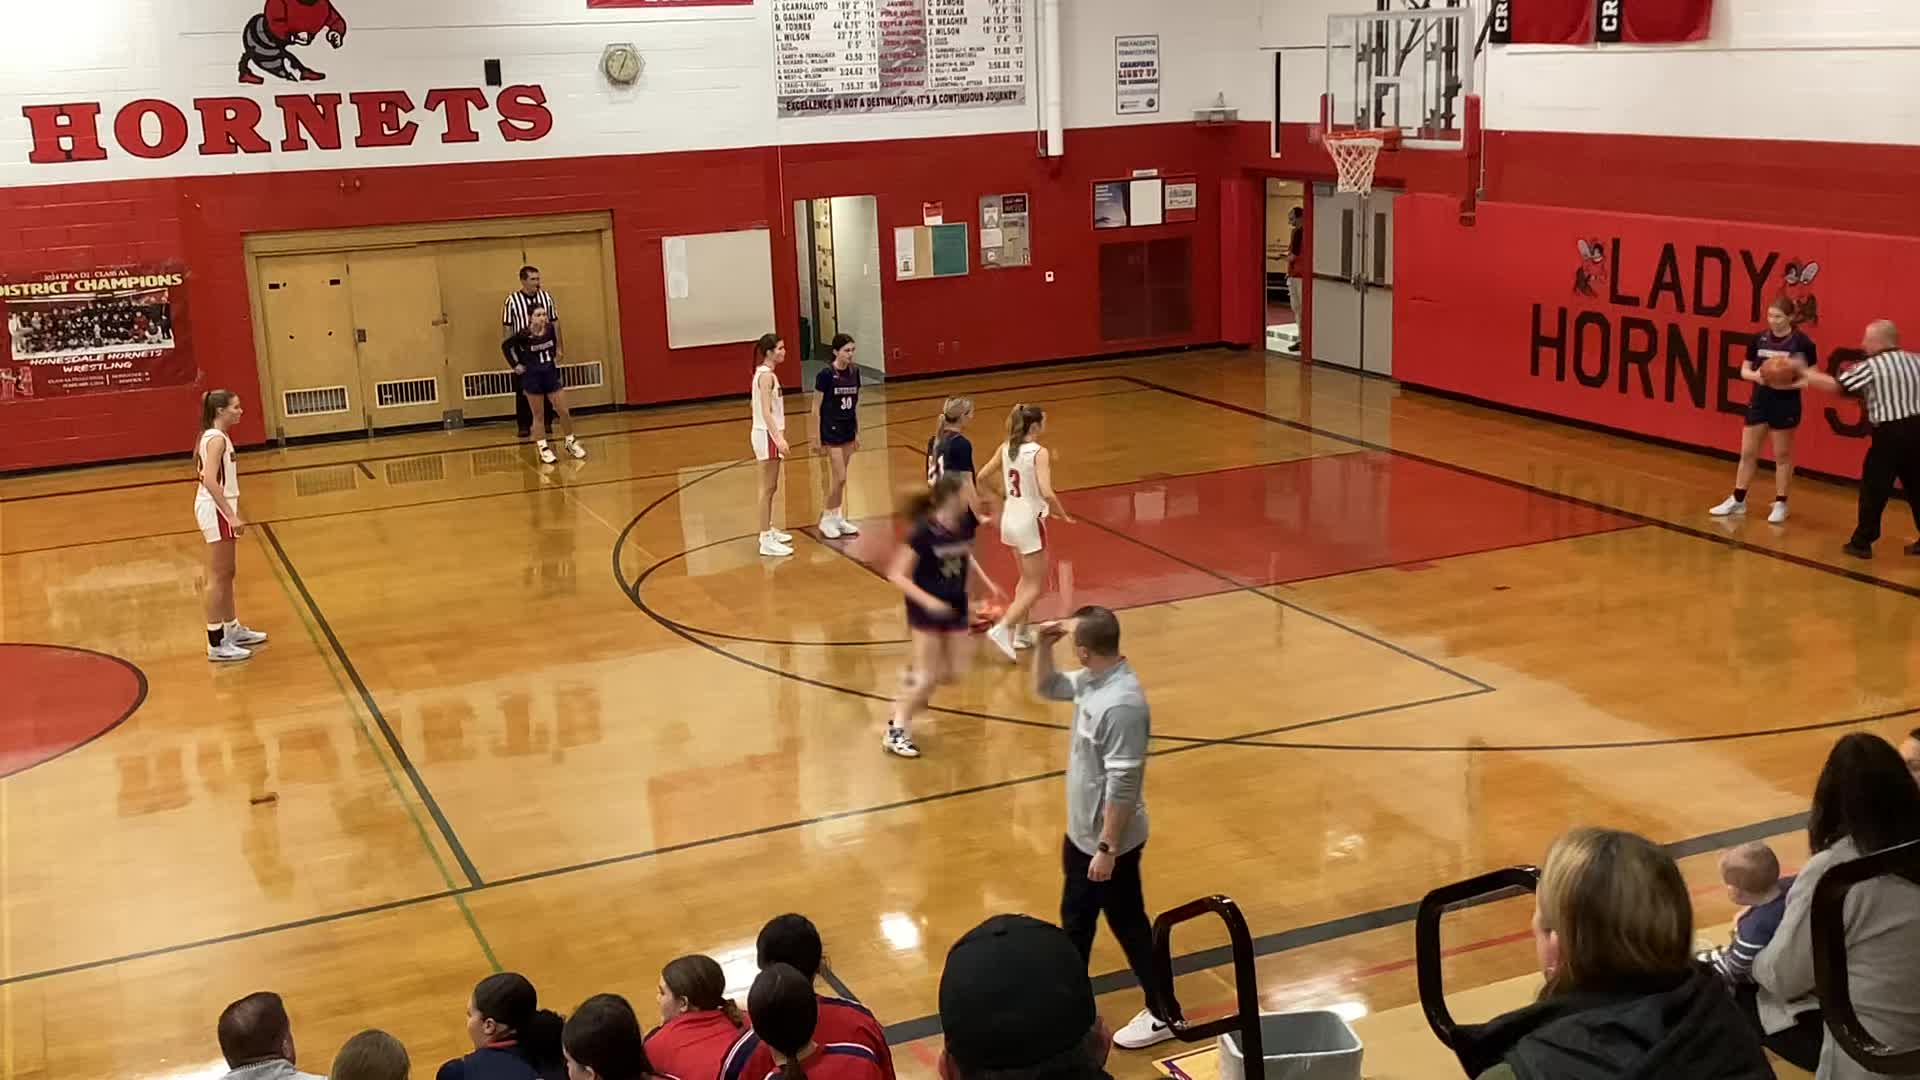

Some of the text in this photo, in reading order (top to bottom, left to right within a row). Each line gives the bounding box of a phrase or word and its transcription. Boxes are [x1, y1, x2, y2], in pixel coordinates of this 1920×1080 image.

[783, 13, 816, 21] GALINSKI
[784, 33, 810, 41] WILSON
[935, 27, 960, 36] WILSON
[786, 90, 1017, 111] EXCELLENCE IS NOT A DESTINATION, IT'S A CONTINUOUS JOURNEY
[21, 83, 554, 165] HORNETS
[0, 273, 183, 297] DISTRICT CHAMPIONS
[1608, 237, 1779, 323] LADY
[30, 349, 163, 366] HONESDALE HORNETS
[63, 361, 133, 373] WRESTLING
[1530, 303, 1869, 439] HORNES
[1007, 468, 1021, 498] 3
